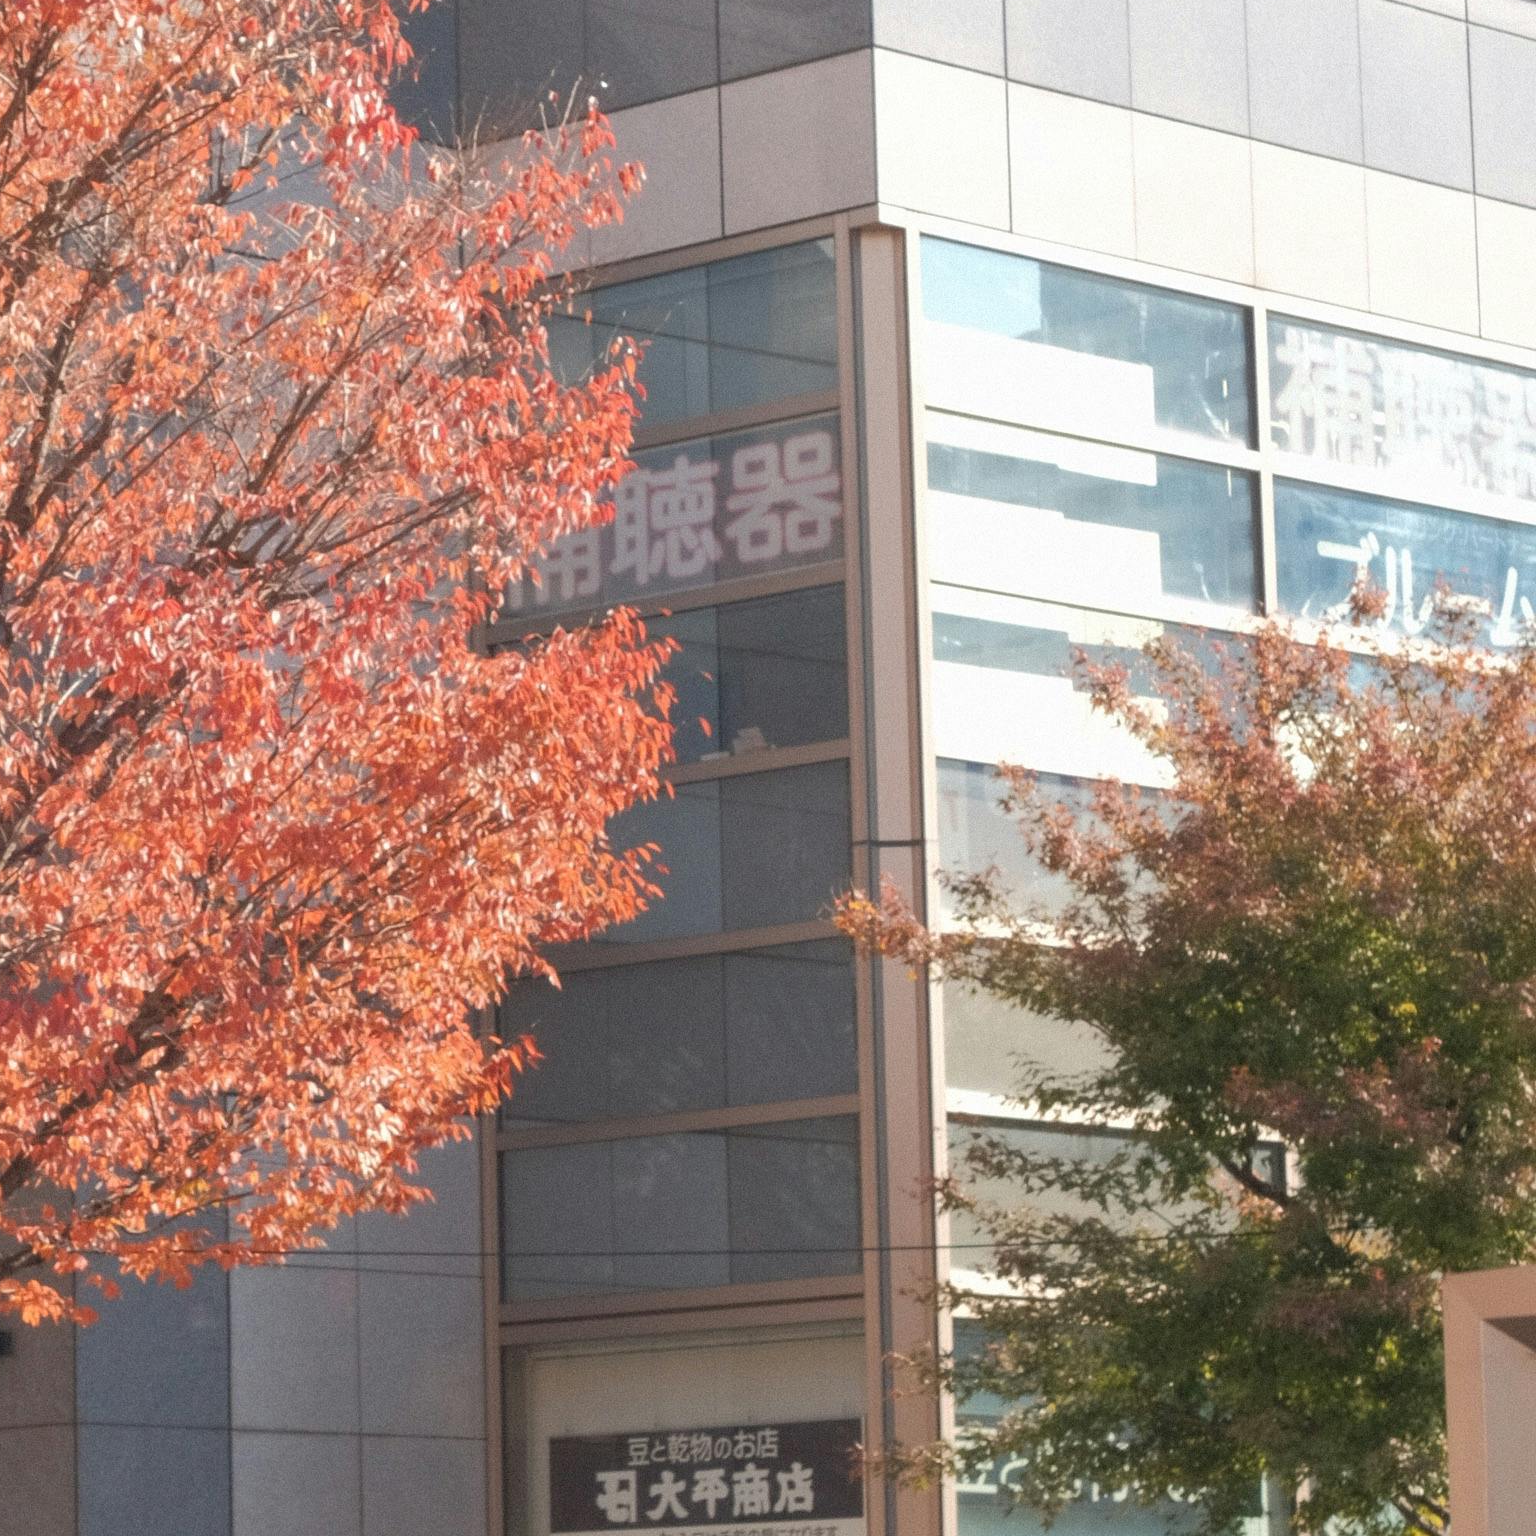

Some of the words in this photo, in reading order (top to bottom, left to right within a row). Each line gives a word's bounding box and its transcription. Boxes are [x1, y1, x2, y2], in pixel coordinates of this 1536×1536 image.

[627, 1429, 779, 1465] 豆と乾物のお店
